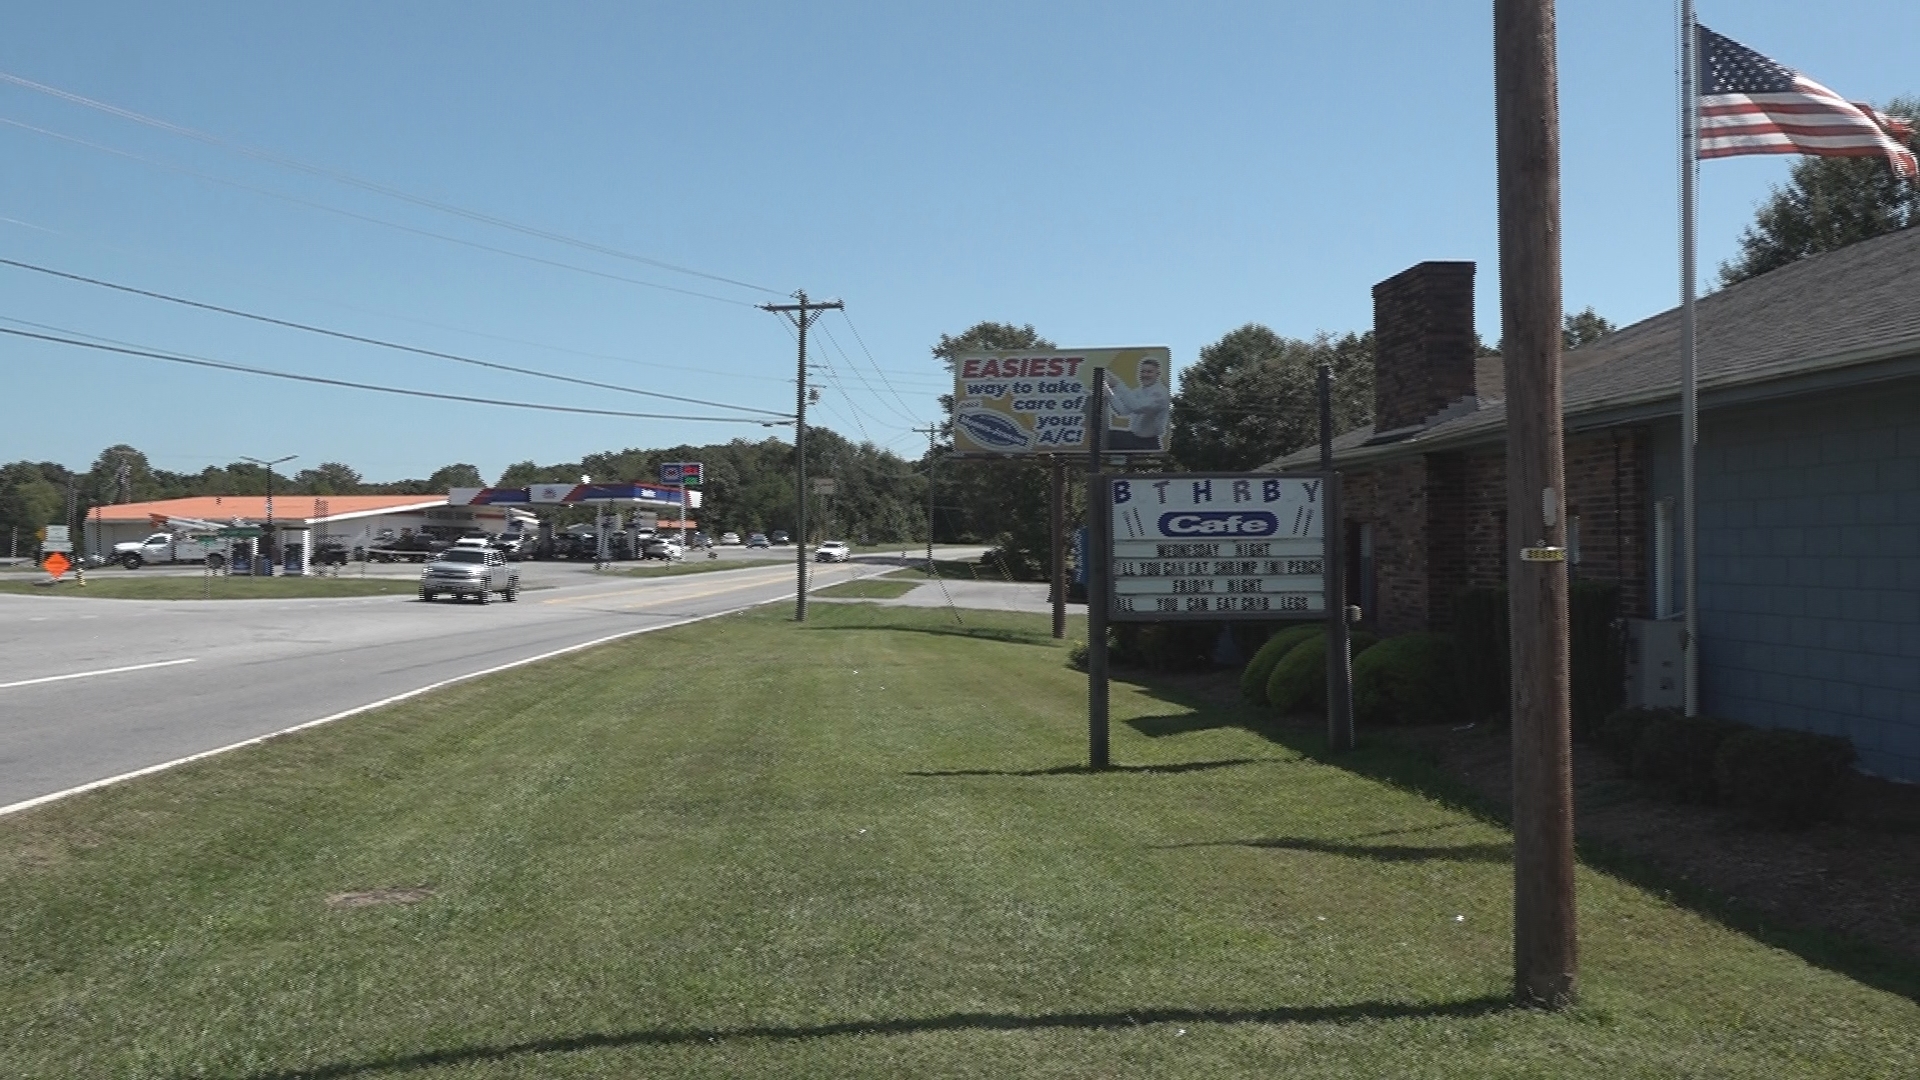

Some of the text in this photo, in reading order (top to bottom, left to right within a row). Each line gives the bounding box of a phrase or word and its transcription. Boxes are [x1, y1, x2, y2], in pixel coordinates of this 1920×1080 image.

[961, 357, 1085, 378] EASIEST
[966, 379, 1082, 397] way to take
[1013, 396, 1085, 410] care of
[1036, 414, 1082, 429] your
[1038, 429, 1082, 444] A/C!
[1167, 515, 1269, 534] Cafe
[1156, 543, 1271, 559] WEDNESDAY NIGHT
[1140, 561, 1161, 576] YOU
[1163, 561, 1186, 575] CAN
[1188, 561, 1209, 575] EAT
[1213, 560, 1258, 575] SHRIMP
[1287, 559, 1323, 575] PERCH
[1227, 579, 1264, 594] NIGHT
[1114, 597, 1309, 612] ALL YOU CAN EAT CRAB LEGS
